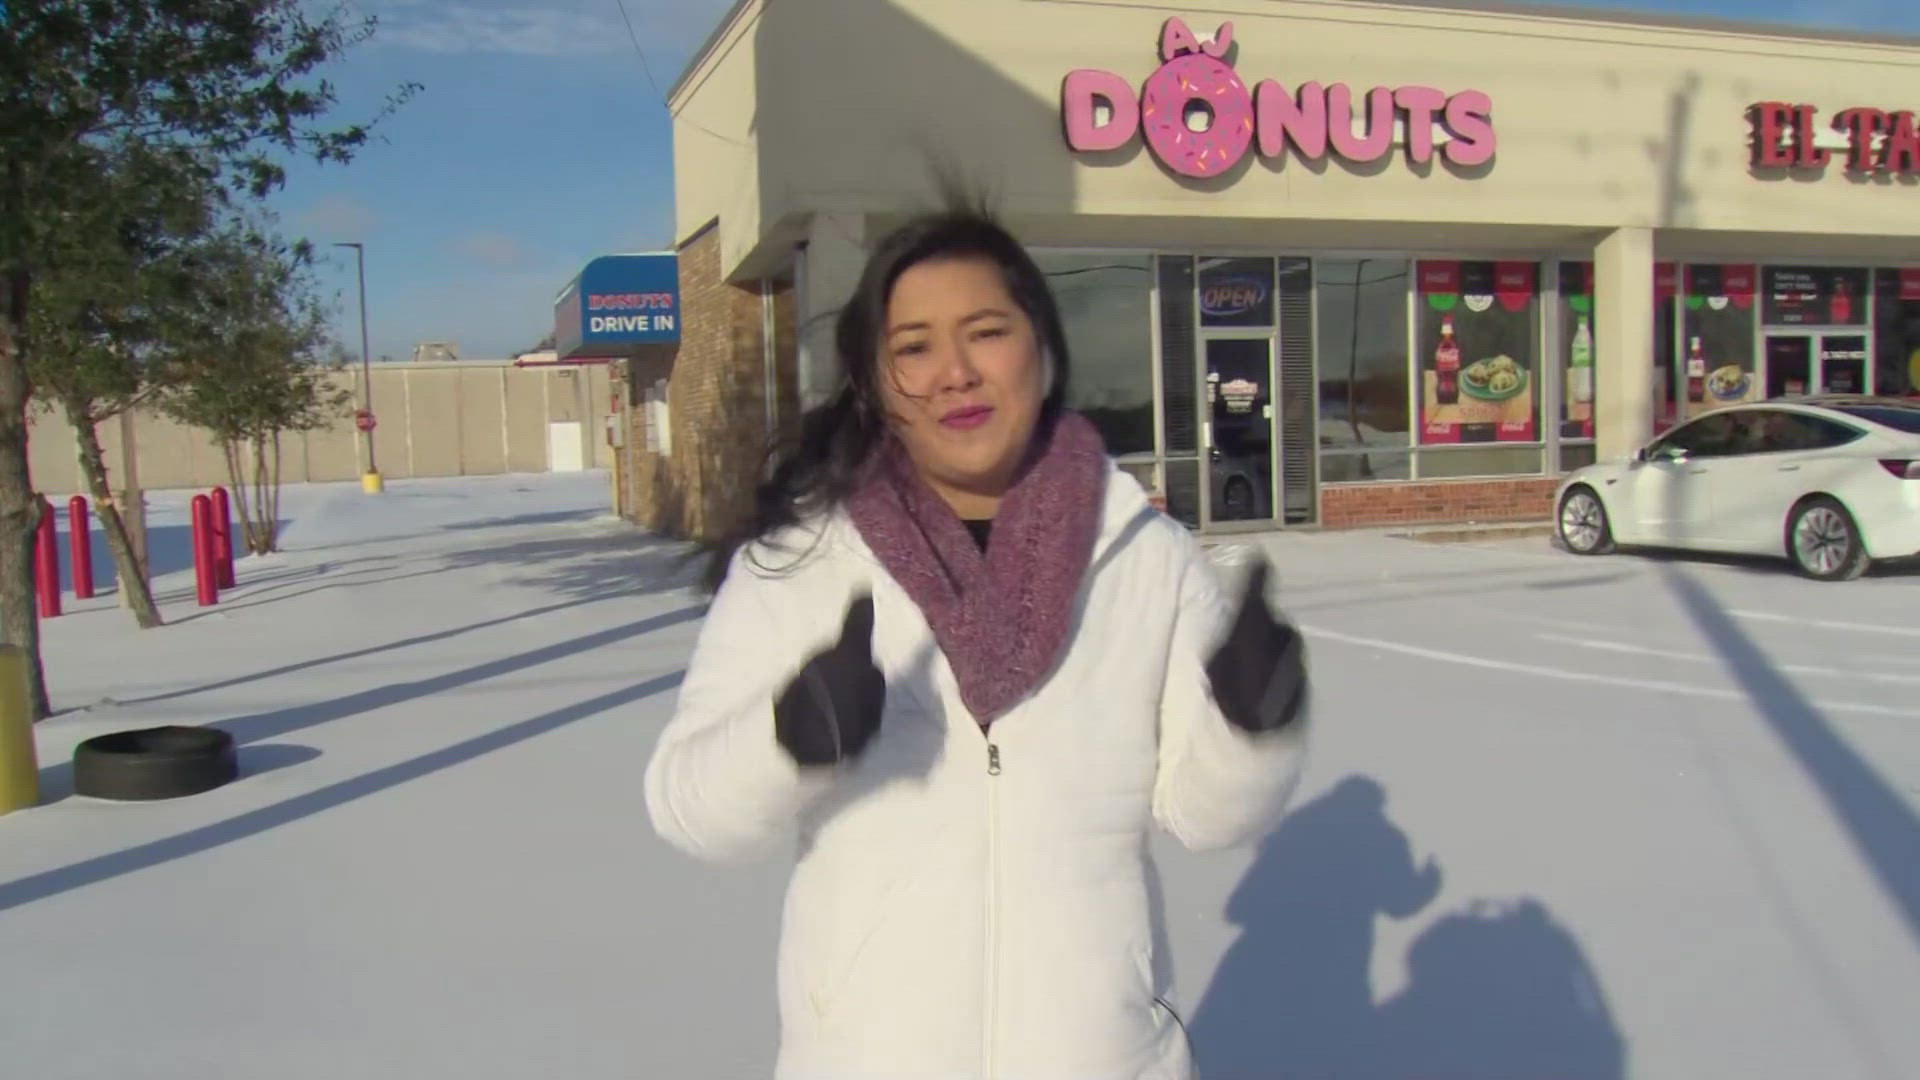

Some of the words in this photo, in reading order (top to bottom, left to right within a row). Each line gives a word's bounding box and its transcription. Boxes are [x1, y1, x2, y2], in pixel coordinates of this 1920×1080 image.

[1161, 16, 1234, 60] AJ
[1062, 53, 1497, 177] DONUTS
[1746, 101, 1831, 169] EL
[1831, 107, 1920, 173] TA
[588, 292, 673, 310] DONUTS
[1204, 286, 1257, 308] OPEN
[591, 315, 649, 332] DRIVE
[653, 315, 674, 331] IN
